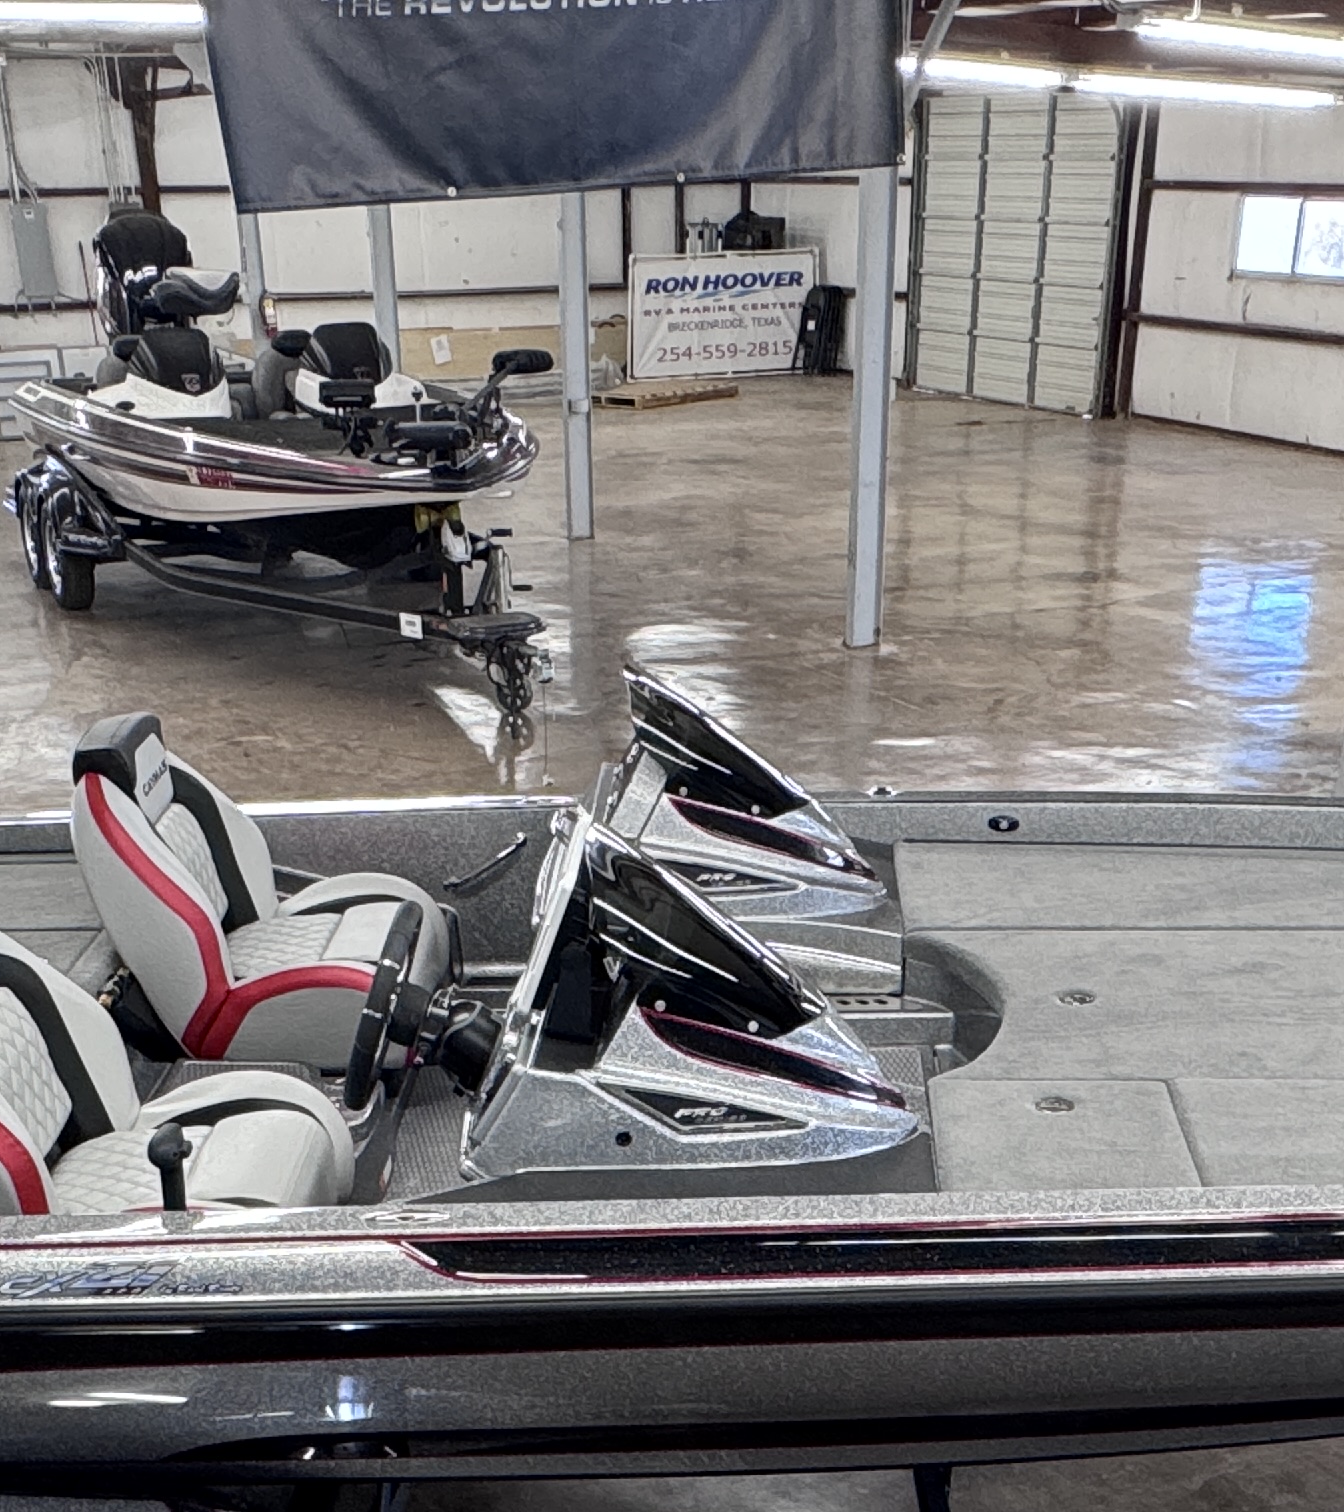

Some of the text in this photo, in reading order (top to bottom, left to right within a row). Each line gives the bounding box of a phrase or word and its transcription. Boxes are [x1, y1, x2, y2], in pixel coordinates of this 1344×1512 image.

[644, 270, 805, 296] RON HOOVER
[680, 303, 736, 315] MARINE
[751, 316, 783, 328] TEXAS
[656, 339, 794, 363] 254-559-2815
